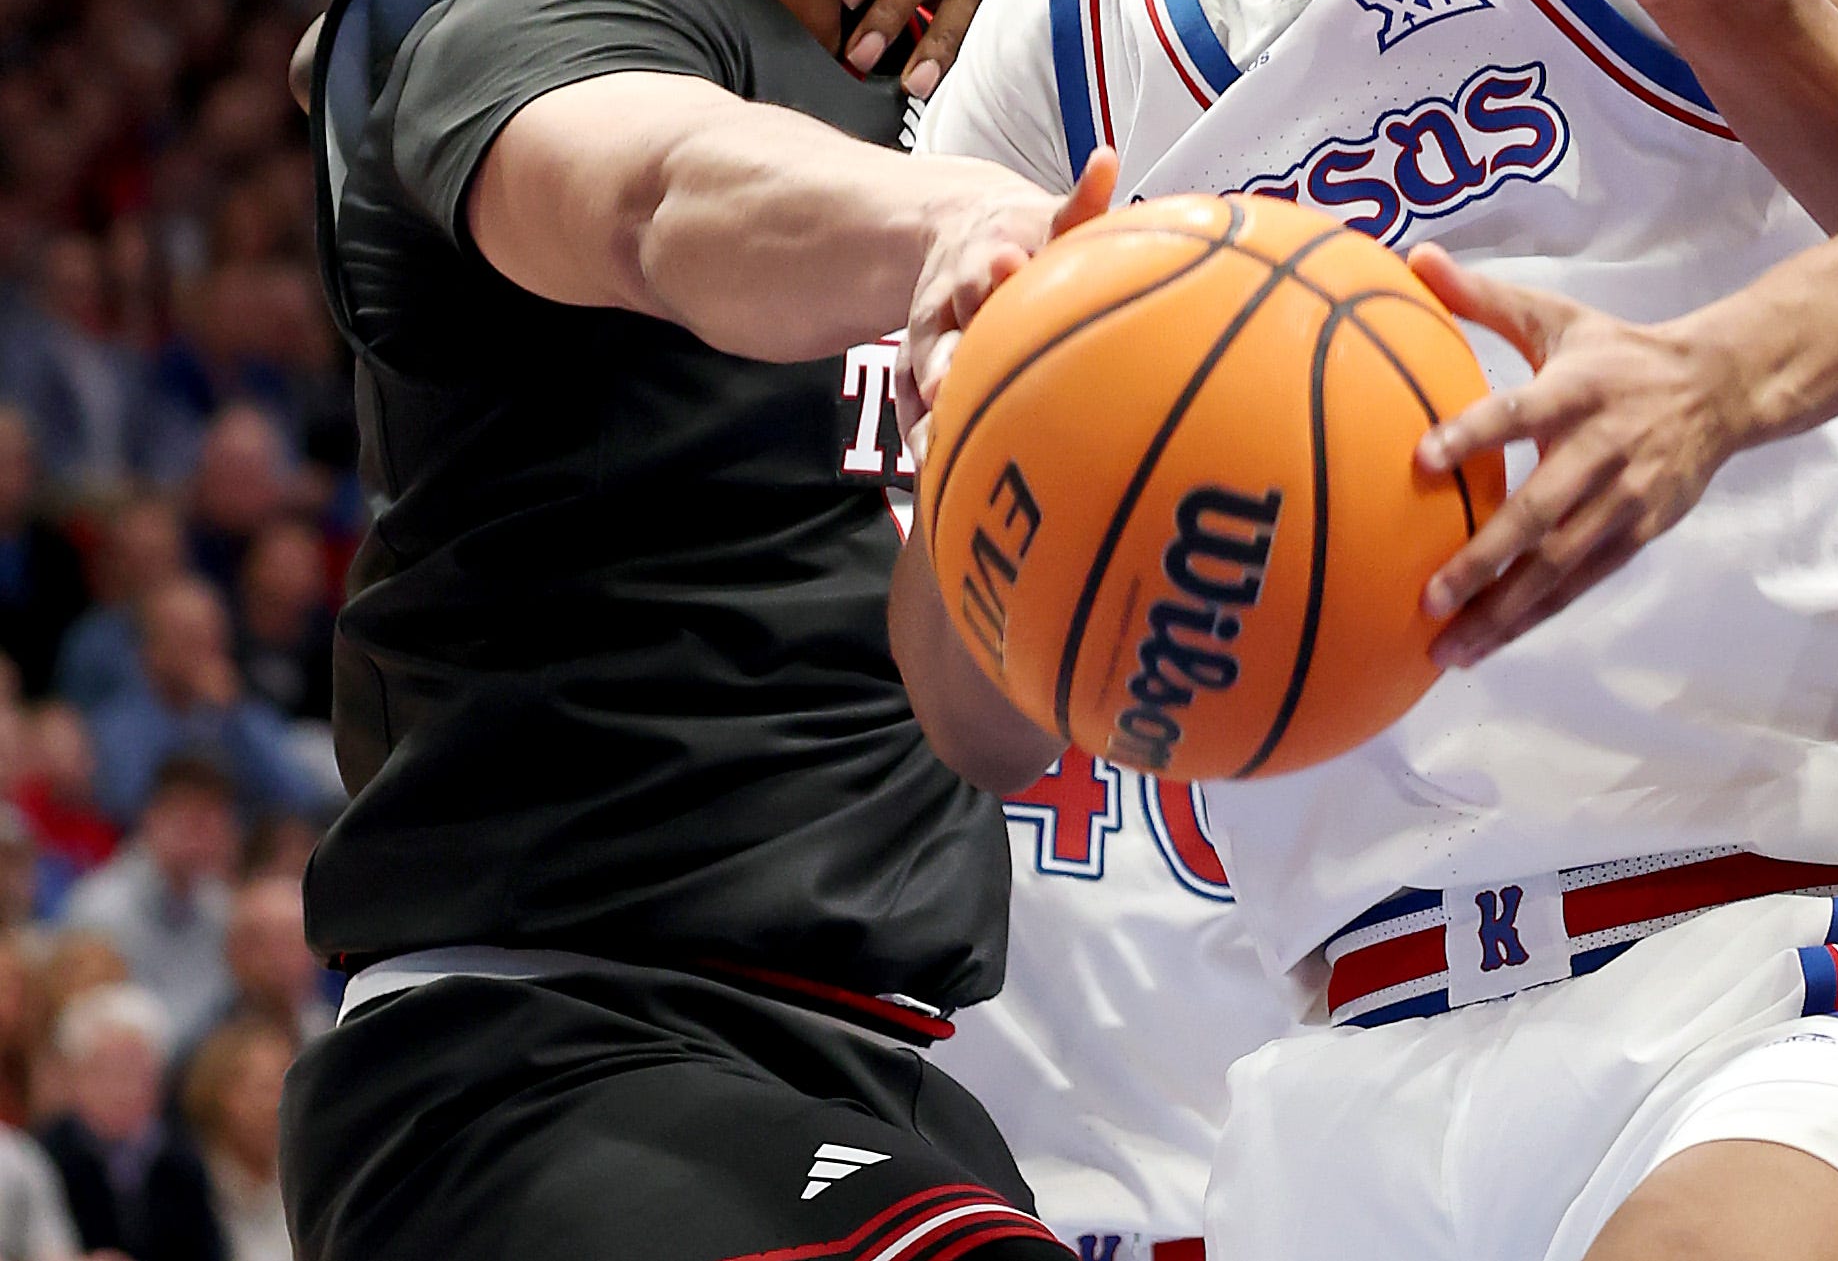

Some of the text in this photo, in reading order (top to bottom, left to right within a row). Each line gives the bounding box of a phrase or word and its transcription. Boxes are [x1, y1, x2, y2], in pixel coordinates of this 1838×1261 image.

[1225, 62, 1570, 248] sas
[1108, 481, 1284, 771] Wilson
[1475, 885, 1530, 972] K
